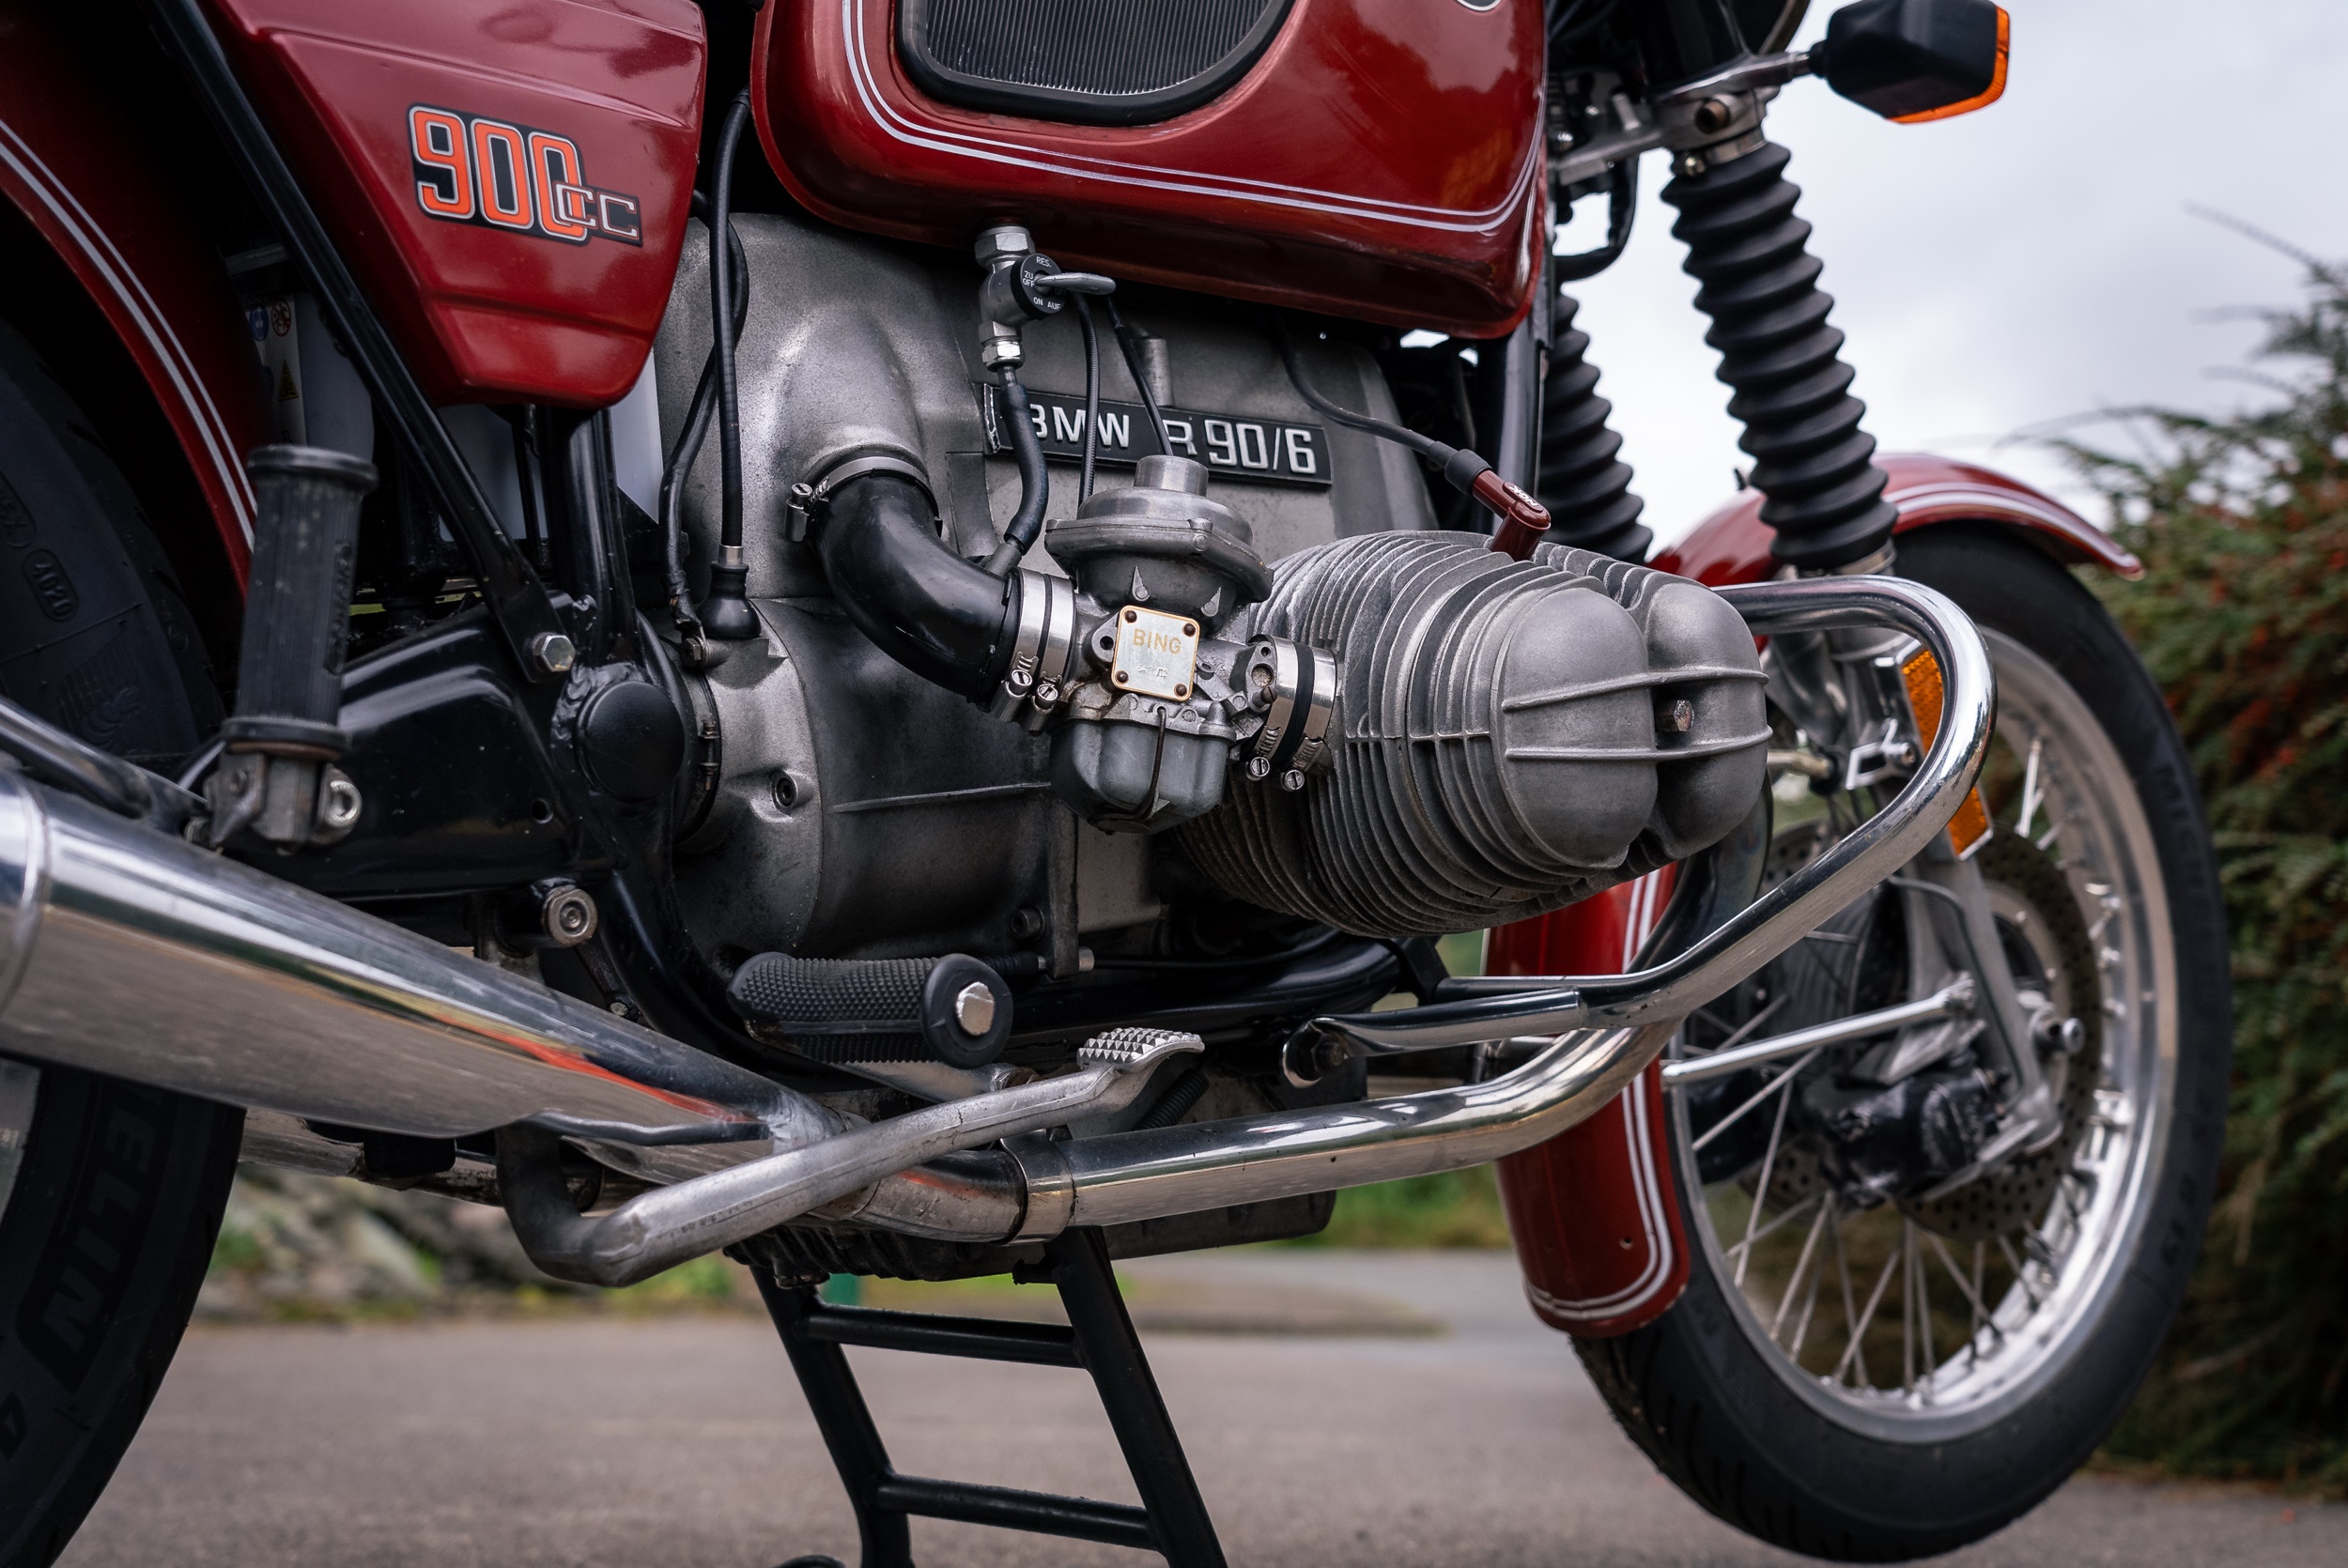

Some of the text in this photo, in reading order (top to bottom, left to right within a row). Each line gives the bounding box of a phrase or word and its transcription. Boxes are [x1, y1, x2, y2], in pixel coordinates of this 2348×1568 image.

[1036, 256, 1052, 268] RES.
[1024, 270, 1034, 280] ZU
[1022, 278, 1035, 287] OFF
[1033, 297, 1061, 311] ON AUF
[1028, 404, 1317, 474] BMW R 90/6
[1133, 628, 1182, 654] BING
[43, 1089, 164, 1353] ELIN
